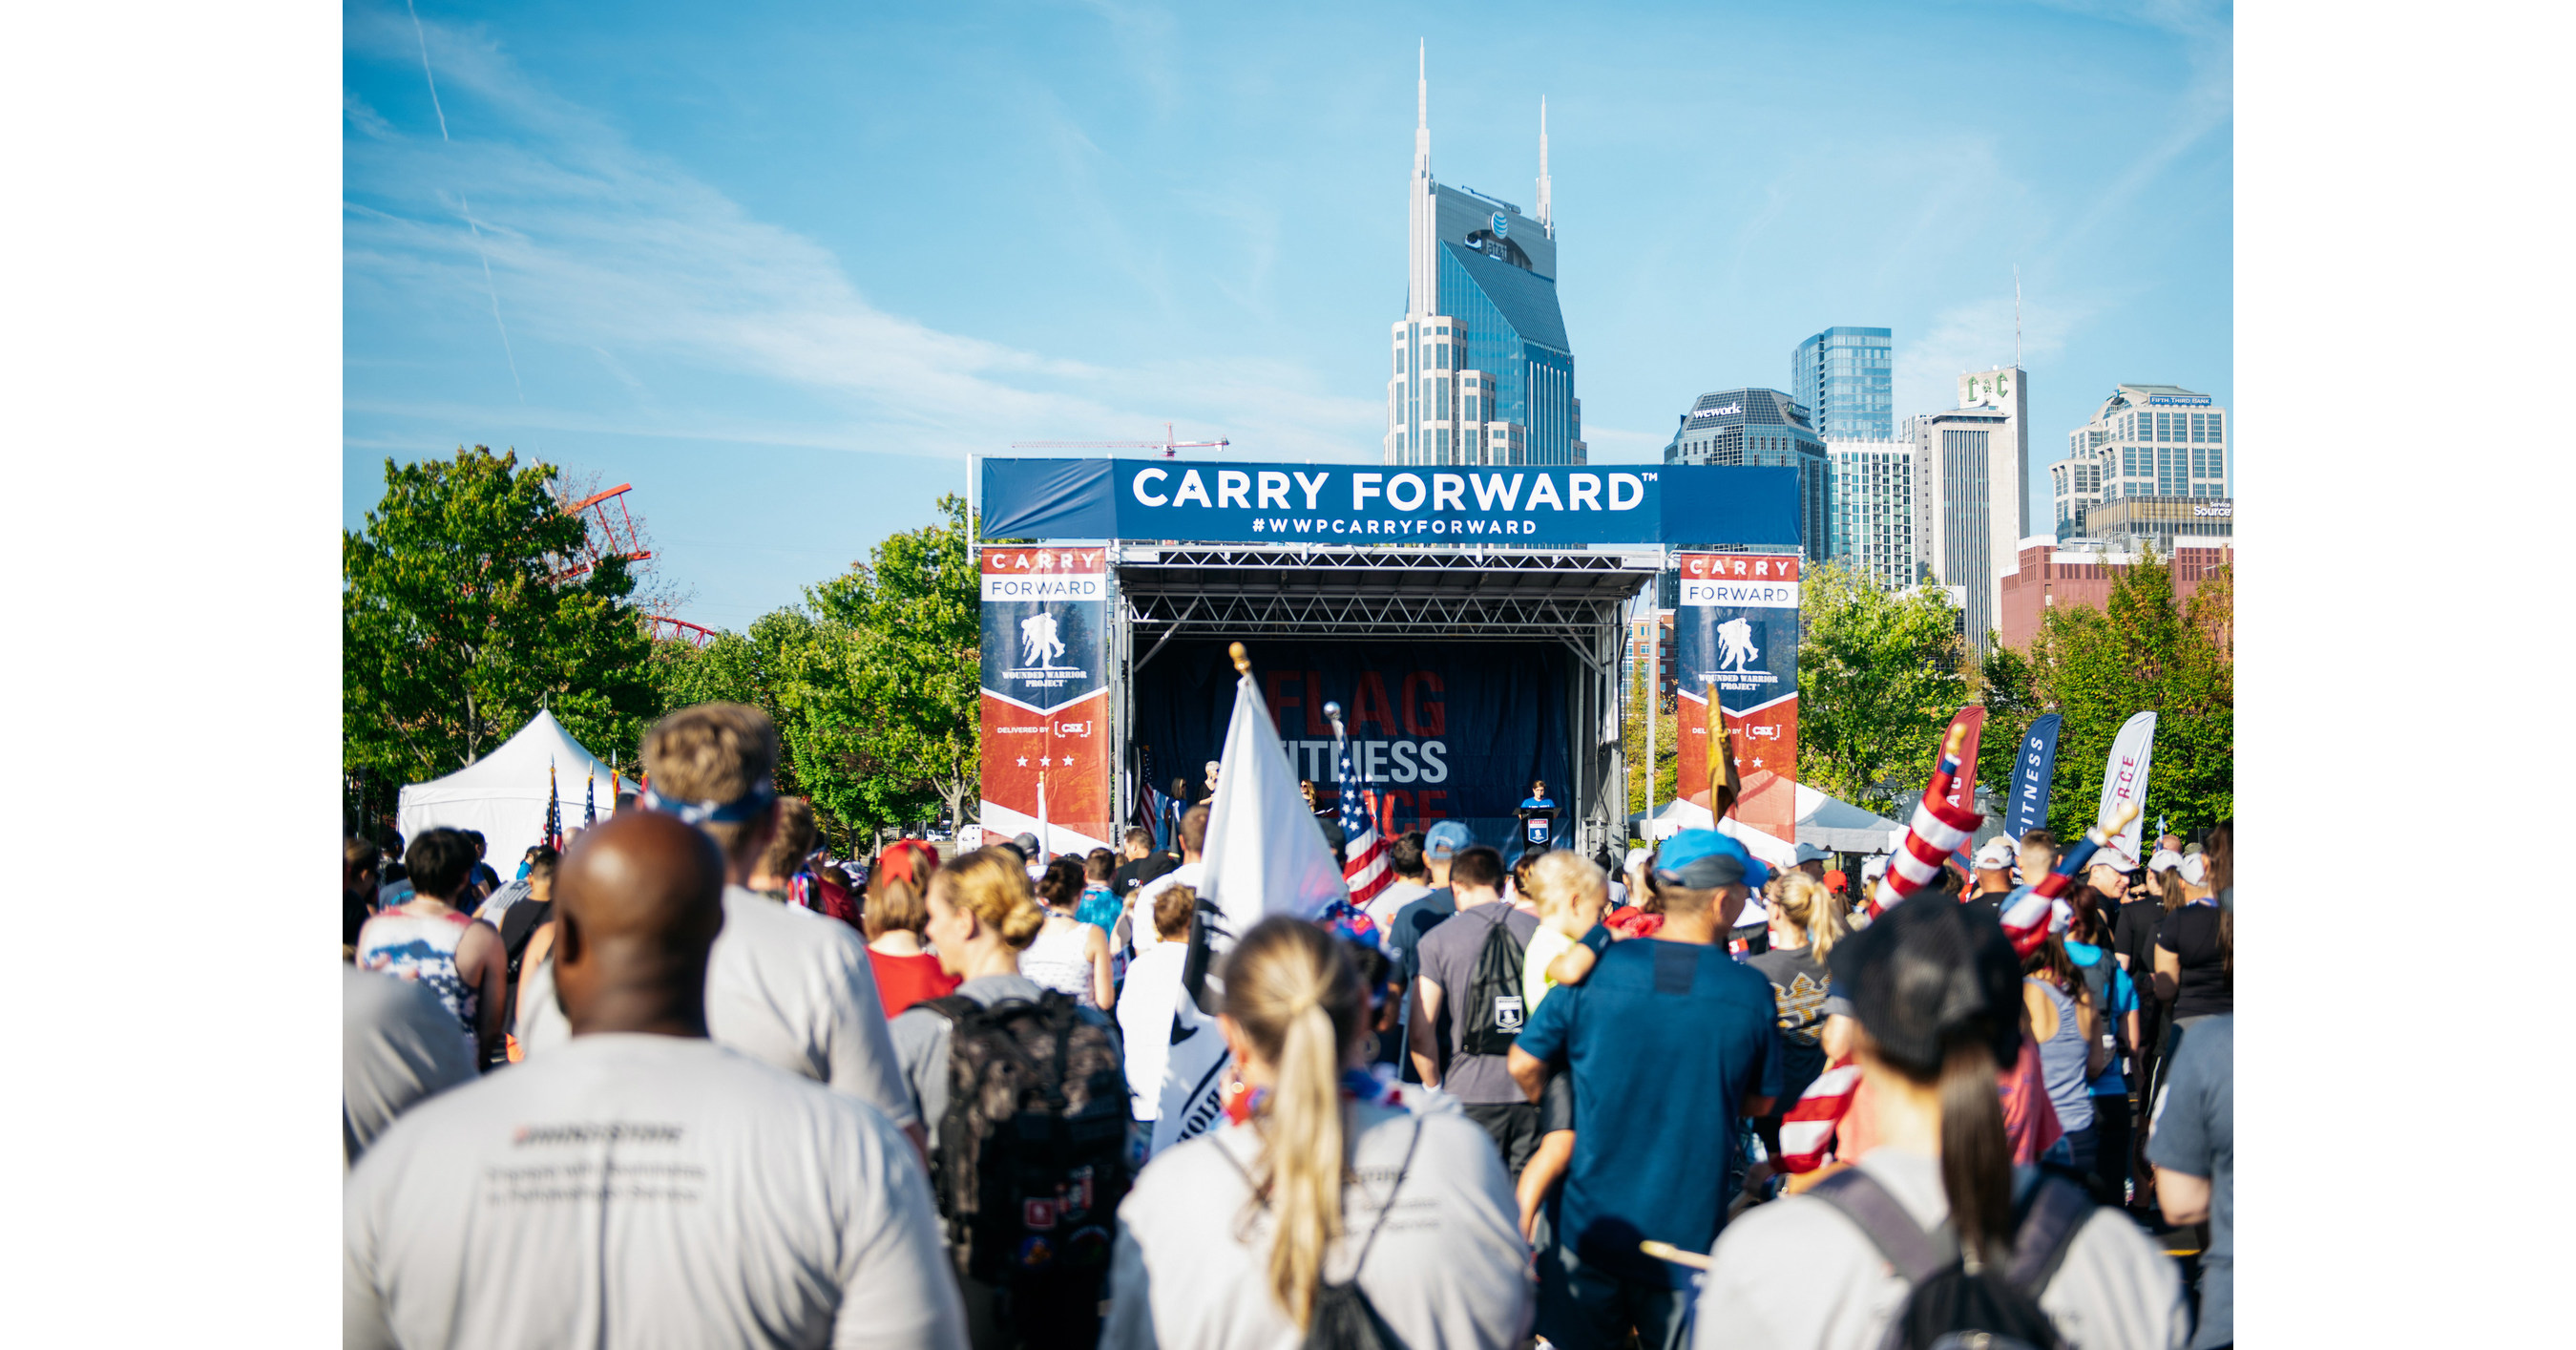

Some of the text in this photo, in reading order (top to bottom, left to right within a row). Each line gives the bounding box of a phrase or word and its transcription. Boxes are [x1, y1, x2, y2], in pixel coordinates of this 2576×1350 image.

[1693, 402, 1742, 419] wework
[1132, 467, 1330, 510] CARRY
[2193, 506, 2230, 517] Source
[1252, 517, 1537, 536] #WWPCARRYFORWARD
[992, 553, 1096, 569] CARRY
[1689, 559, 1790, 577] CARRY
[992, 580, 1096, 596] FORWARD
[1047, 670, 1087, 679] WARRIOR
[1698, 674, 1778, 684] WOUNDED WARRIOR
[1267, 670, 1446, 737] FLAG
[1946, 776, 1962, 809] AG
